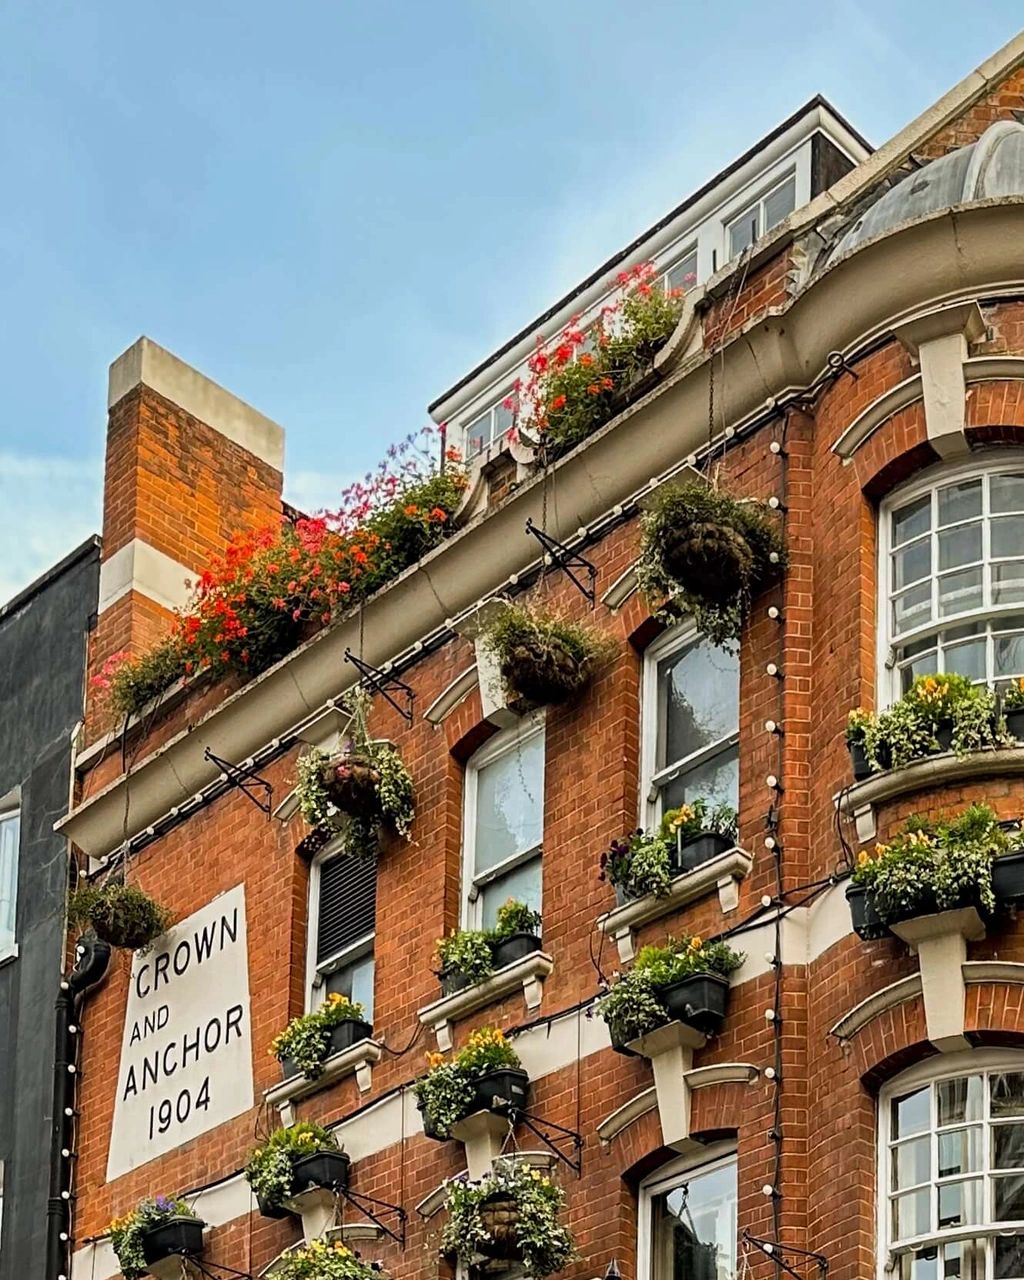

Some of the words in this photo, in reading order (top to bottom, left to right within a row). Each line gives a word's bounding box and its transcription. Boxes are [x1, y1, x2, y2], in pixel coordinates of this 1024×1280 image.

[135, 907, 238, 999] CROWN
[123, 1003, 243, 1102] ANCHOR
[129, 1004, 170, 1047] AND
[149, 1076, 211, 1140] 1904
